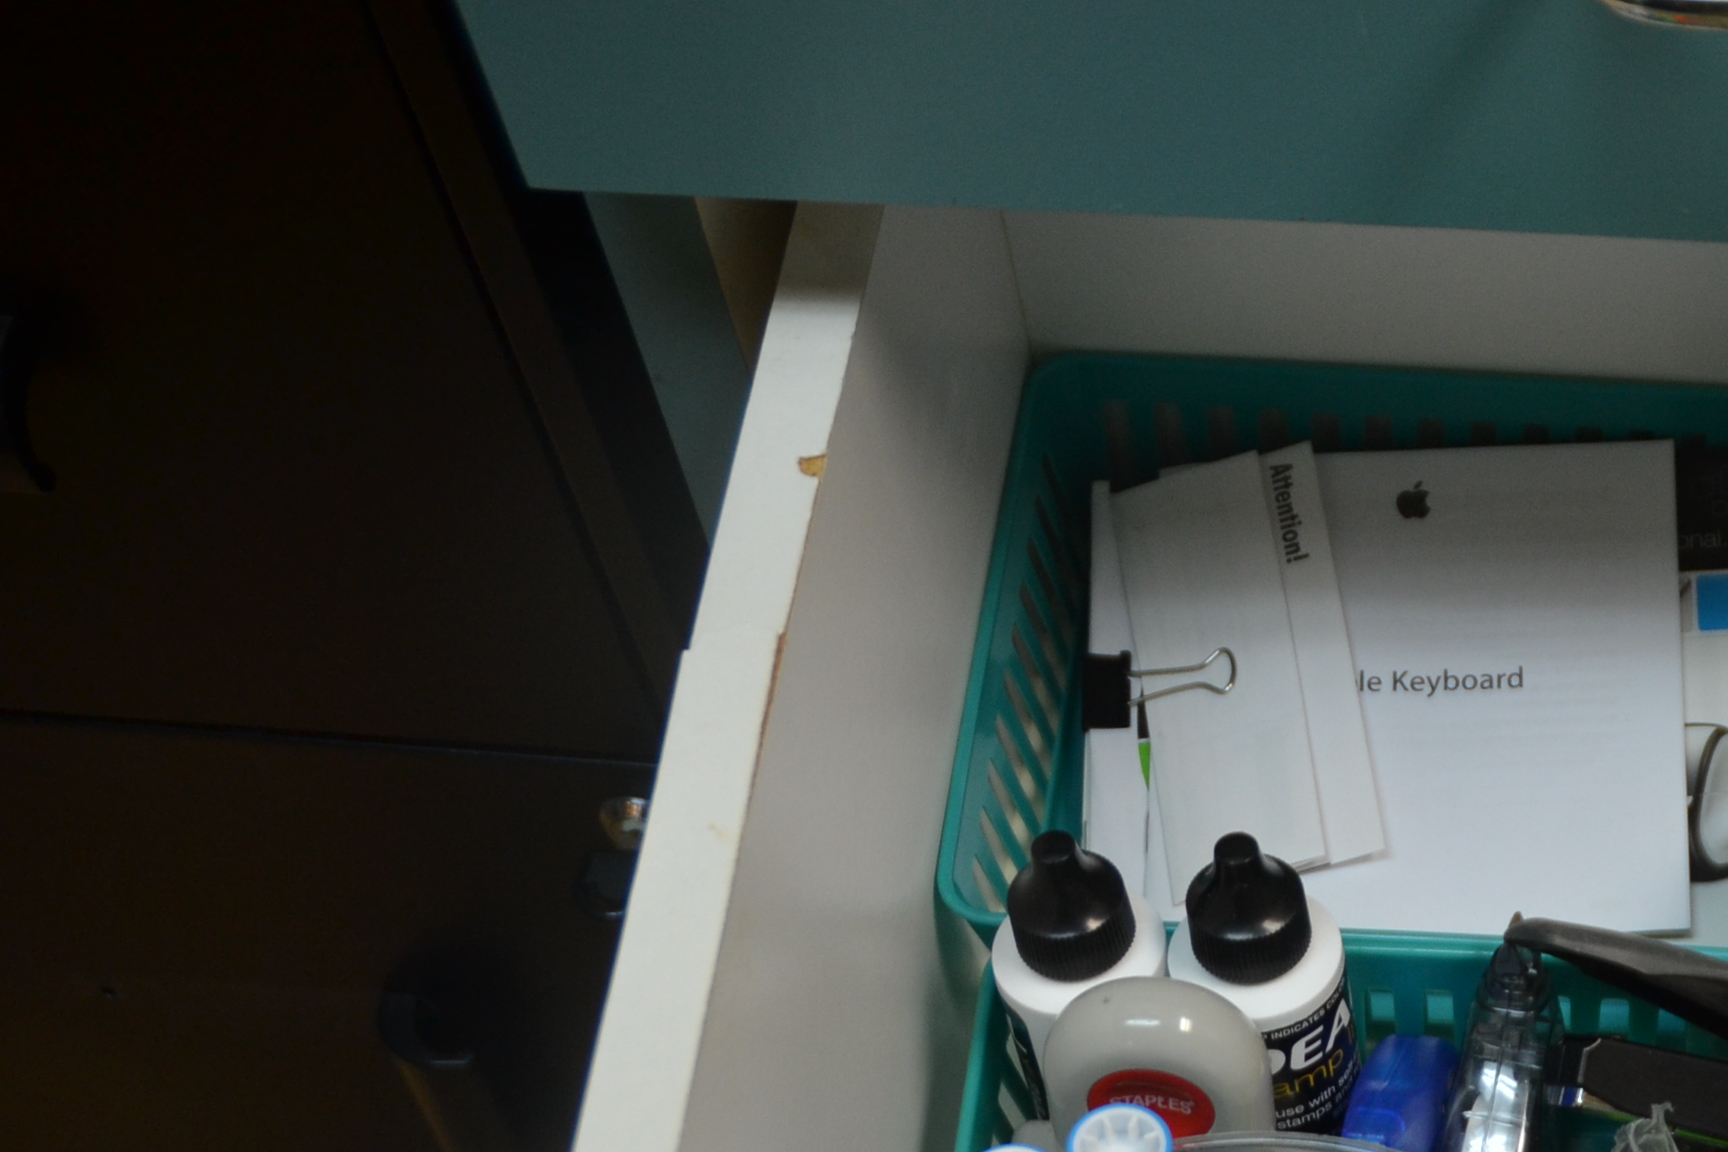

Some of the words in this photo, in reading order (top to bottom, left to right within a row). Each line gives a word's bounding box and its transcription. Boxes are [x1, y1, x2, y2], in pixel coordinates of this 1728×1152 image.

[1269, 463, 1310, 564] Attention!
[1391, 666, 1525, 697] Keyboard
[1271, 1009, 1326, 1040] INDICATES
[1275, 1105, 1304, 1119] use
[1308, 1086, 1337, 1109] with
[1277, 1102, 1333, 1130] stamps
